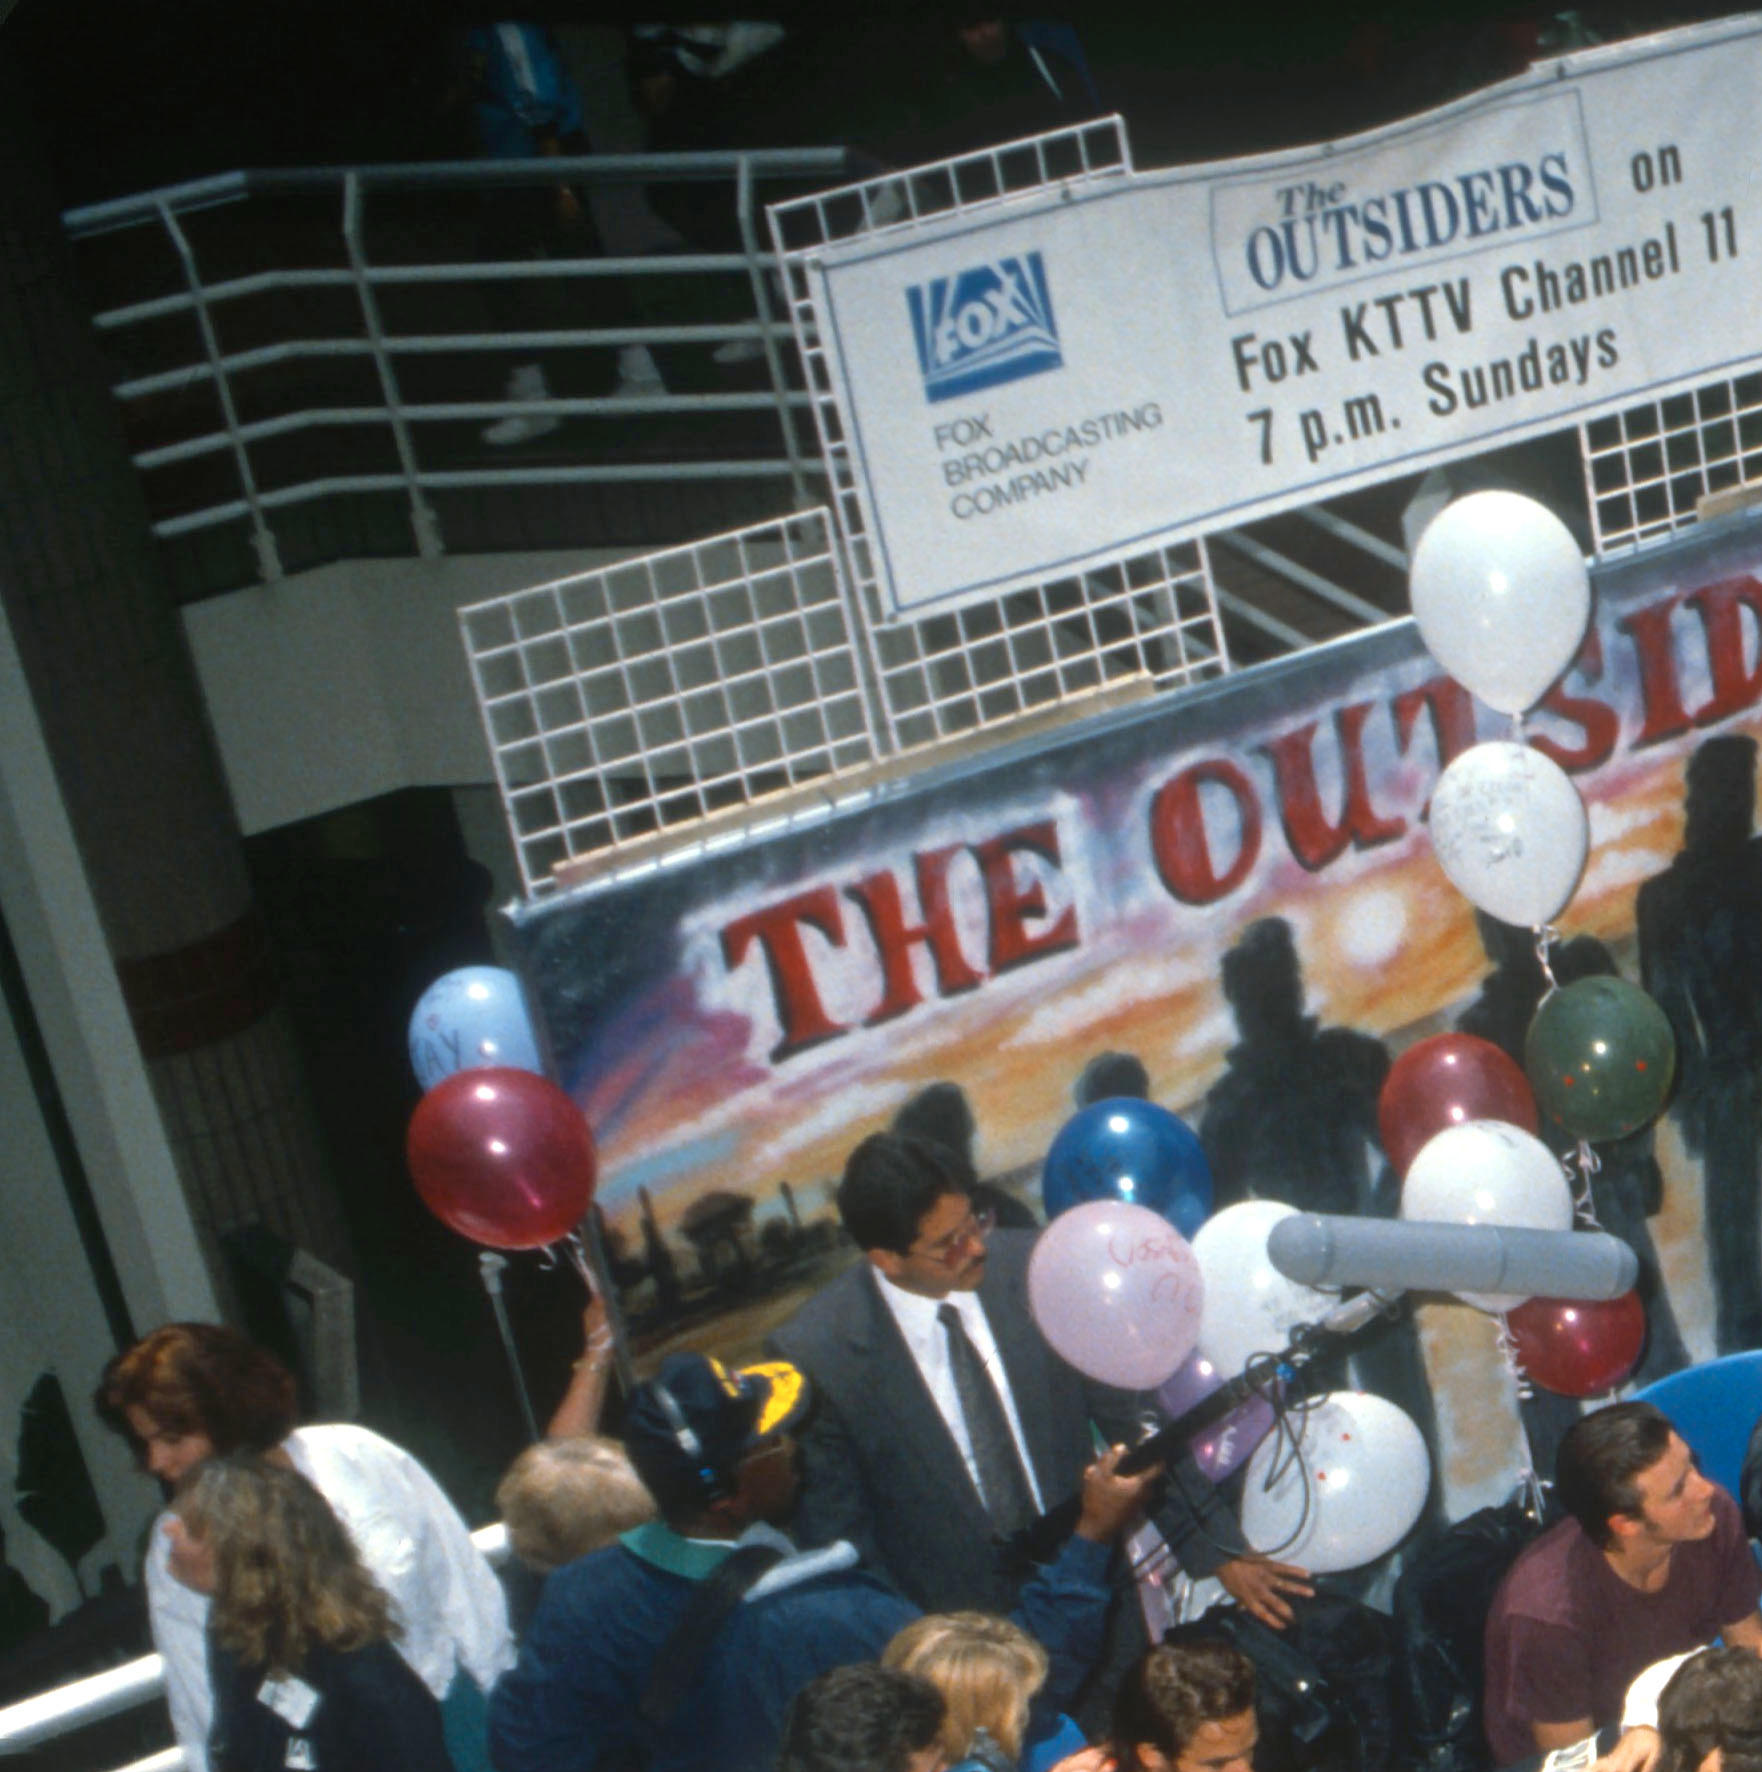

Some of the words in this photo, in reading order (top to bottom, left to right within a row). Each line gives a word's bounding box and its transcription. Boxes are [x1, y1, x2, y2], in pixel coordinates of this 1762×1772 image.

[1245, 151, 1575, 291] OUTSIDERS
[1630, 143, 1683, 193] on
[1276, 180, 1347, 217] The
[1231, 330, 1320, 392] Fox
[1340, 277, 1474, 362] KTTV
[1500, 221, 1680, 322] Channel
[1700, 205, 1739, 264] 11
[932, 413, 994, 451] FOX
[941, 401, 1164, 487] BROADCASTING
[1246, 408, 1274, 466] 7
[1299, 391, 1401, 464] p.m.
[1422, 327, 1620, 417] Sundays
[950, 458, 1090, 520] COMPANY
[719, 820, 1081, 1064] THE
